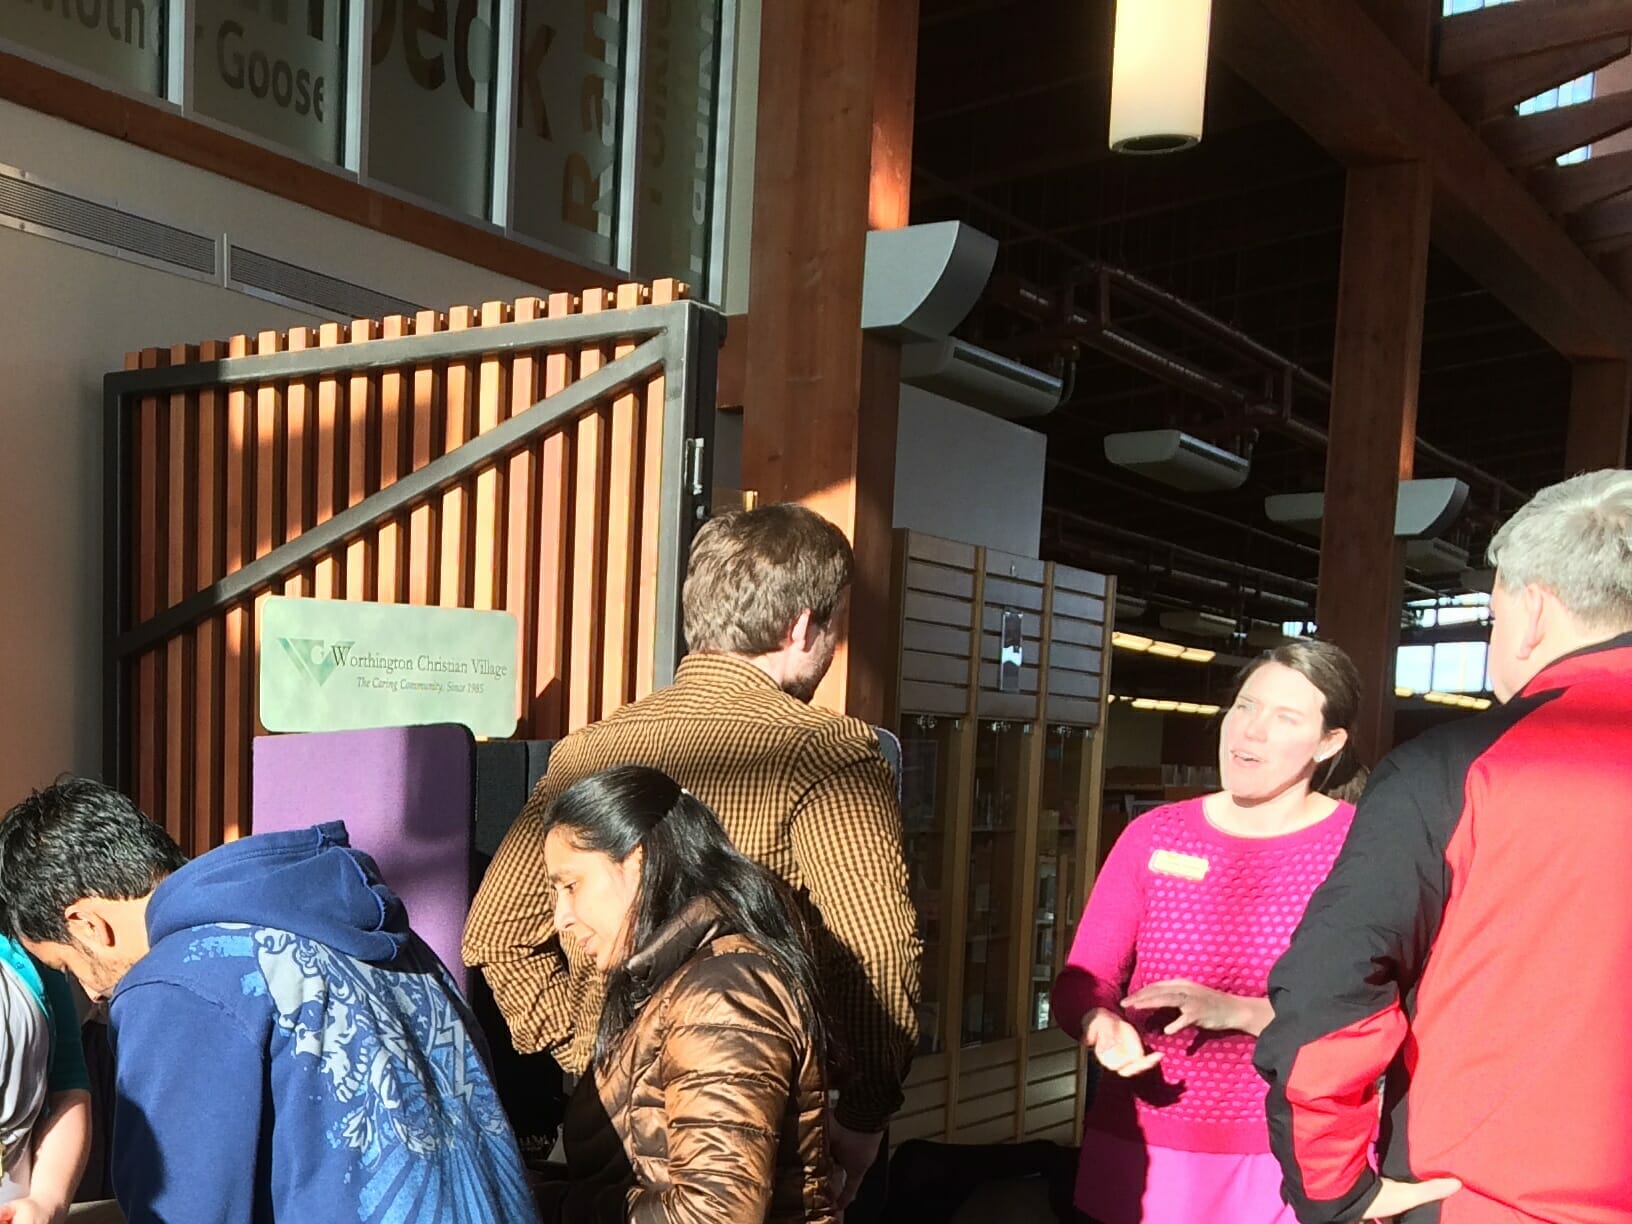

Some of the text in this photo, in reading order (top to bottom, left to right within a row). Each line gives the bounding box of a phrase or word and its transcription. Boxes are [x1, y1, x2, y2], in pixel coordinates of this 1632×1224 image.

[331, 644, 508, 681] Worthington Christian Village
[356, 676, 371, 688] The
[371, 676, 399, 692] Caring
